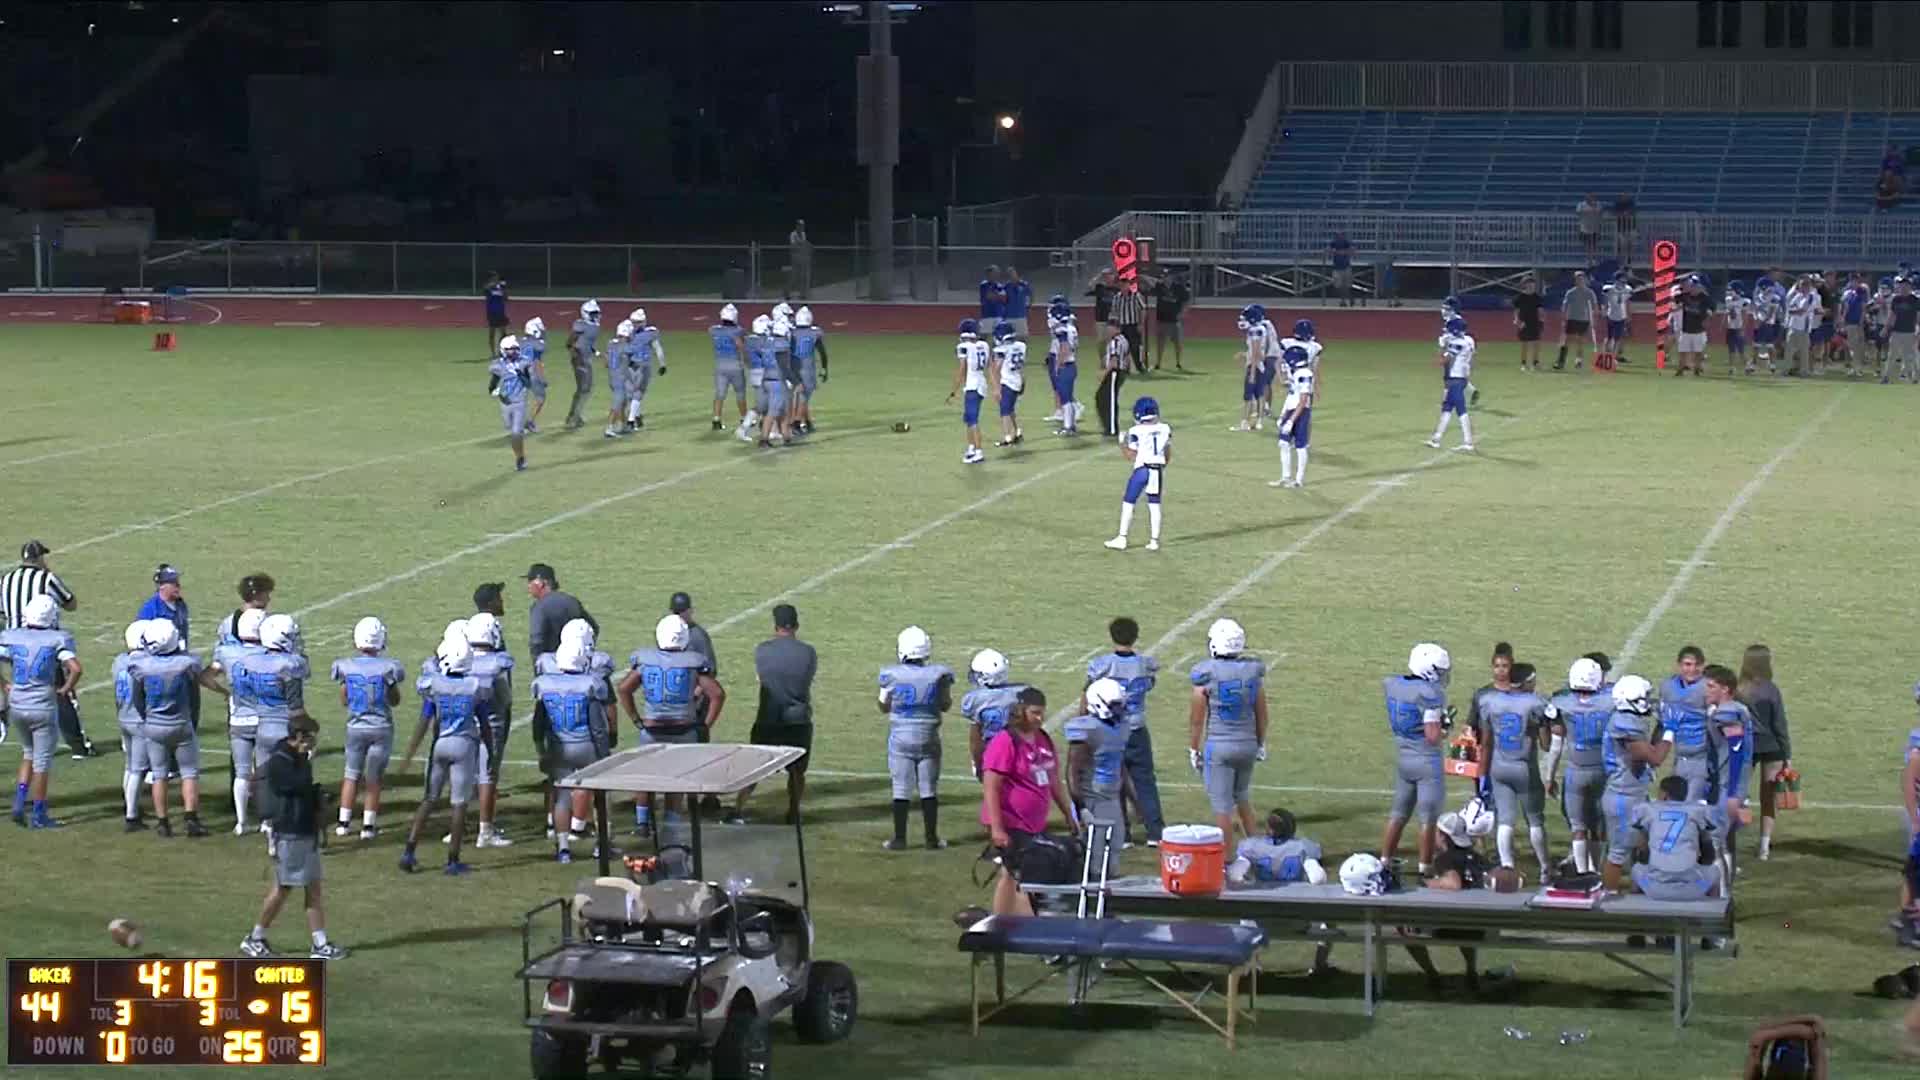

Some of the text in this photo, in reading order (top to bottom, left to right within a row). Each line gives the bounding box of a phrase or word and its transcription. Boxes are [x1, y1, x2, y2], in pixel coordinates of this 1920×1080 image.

[1594, 353, 1613, 370] 40
[1500, 712, 1522, 751] 2
[1659, 811, 1688, 853] 7
